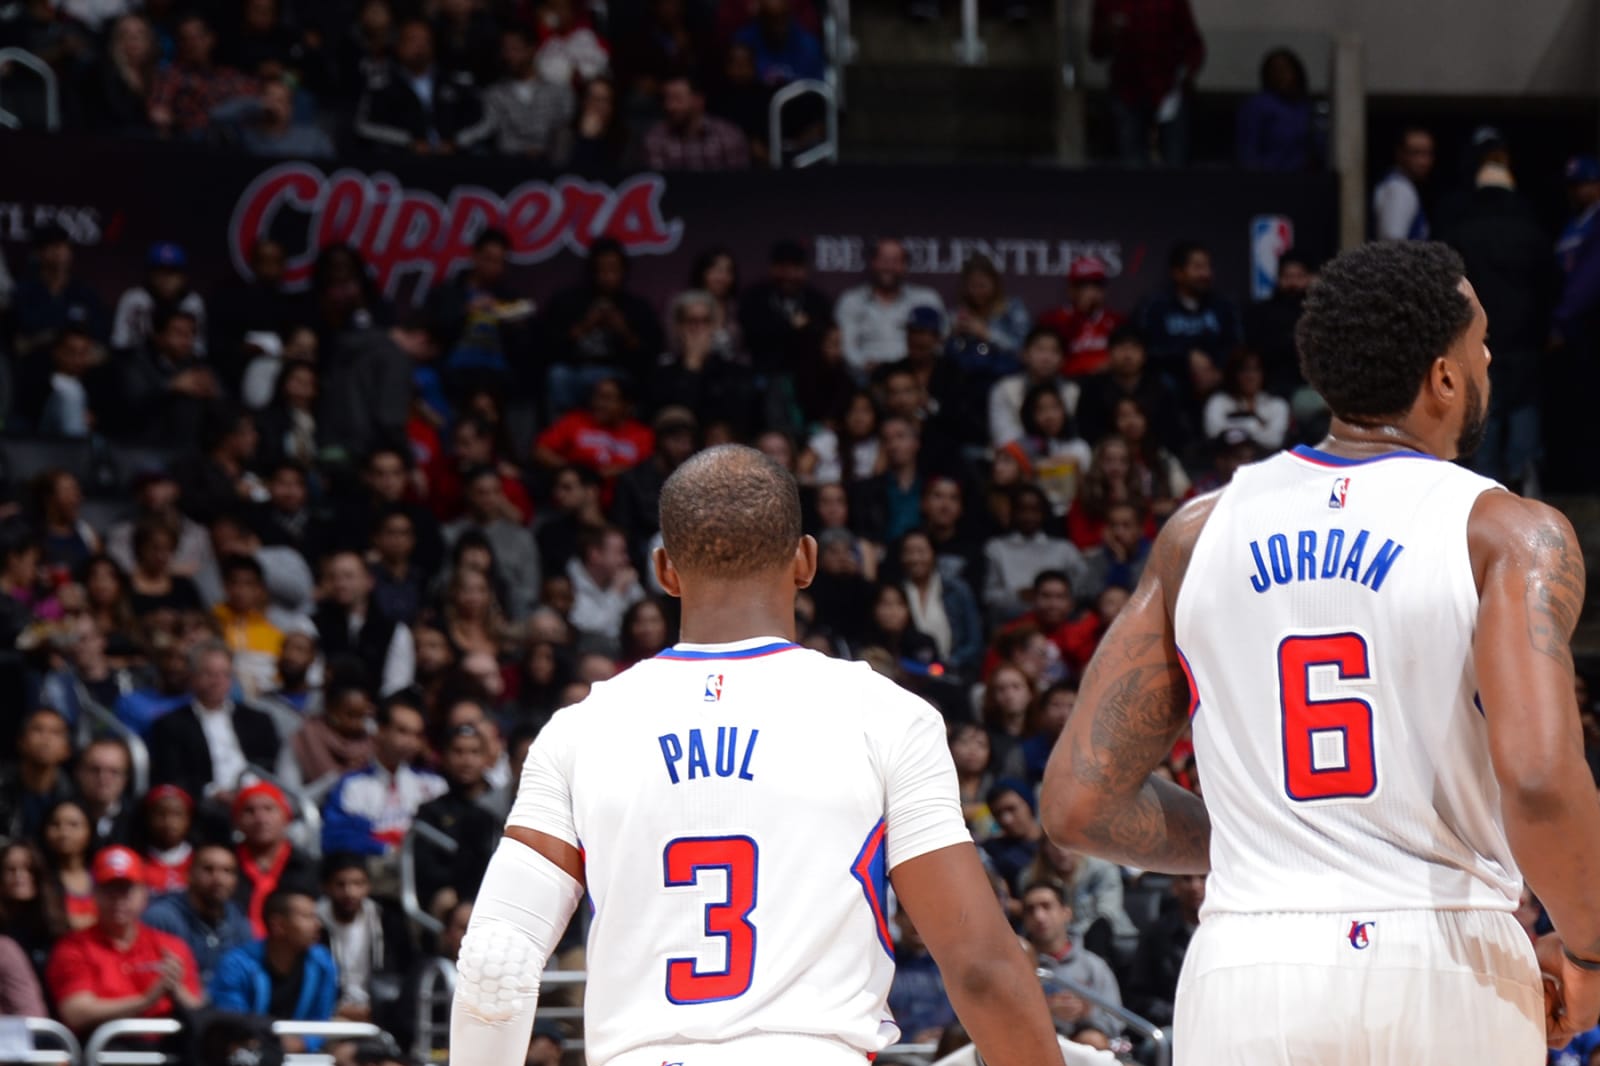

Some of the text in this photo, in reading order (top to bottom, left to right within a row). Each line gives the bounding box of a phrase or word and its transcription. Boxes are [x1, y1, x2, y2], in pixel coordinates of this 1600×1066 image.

[813, 234, 865, 273] BE
[1249, 528, 1404, 593] JORDAN
[1277, 631, 1378, 802] 6
[658, 726, 759, 785] PAUL
[663, 834, 759, 1006] 3
